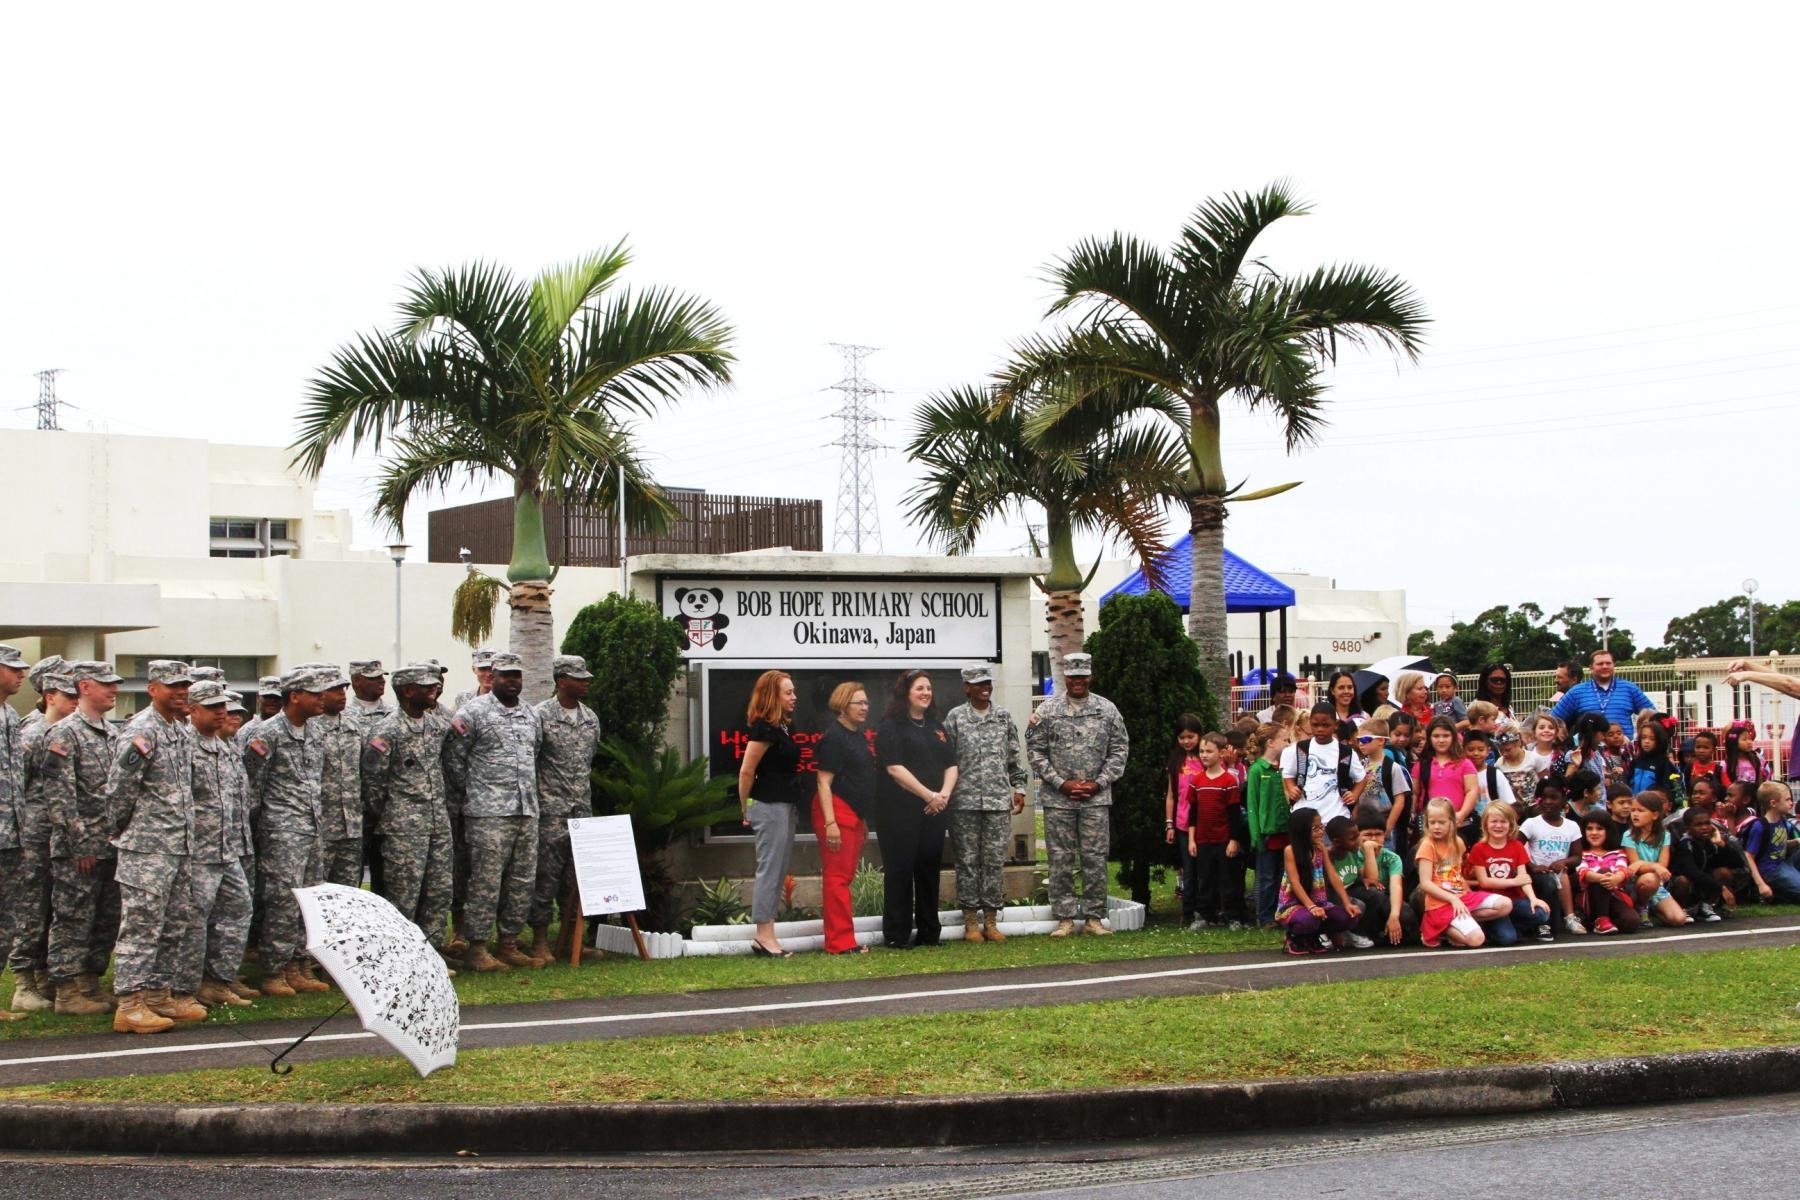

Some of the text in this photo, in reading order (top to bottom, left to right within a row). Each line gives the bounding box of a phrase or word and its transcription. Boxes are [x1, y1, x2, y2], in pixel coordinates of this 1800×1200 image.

[736, 590, 989, 618] BOB HOPE PRIMARY SCHOOL
[793, 621, 936, 651] Okinawa, Japan
[1332, 640, 1362, 653] 9480
